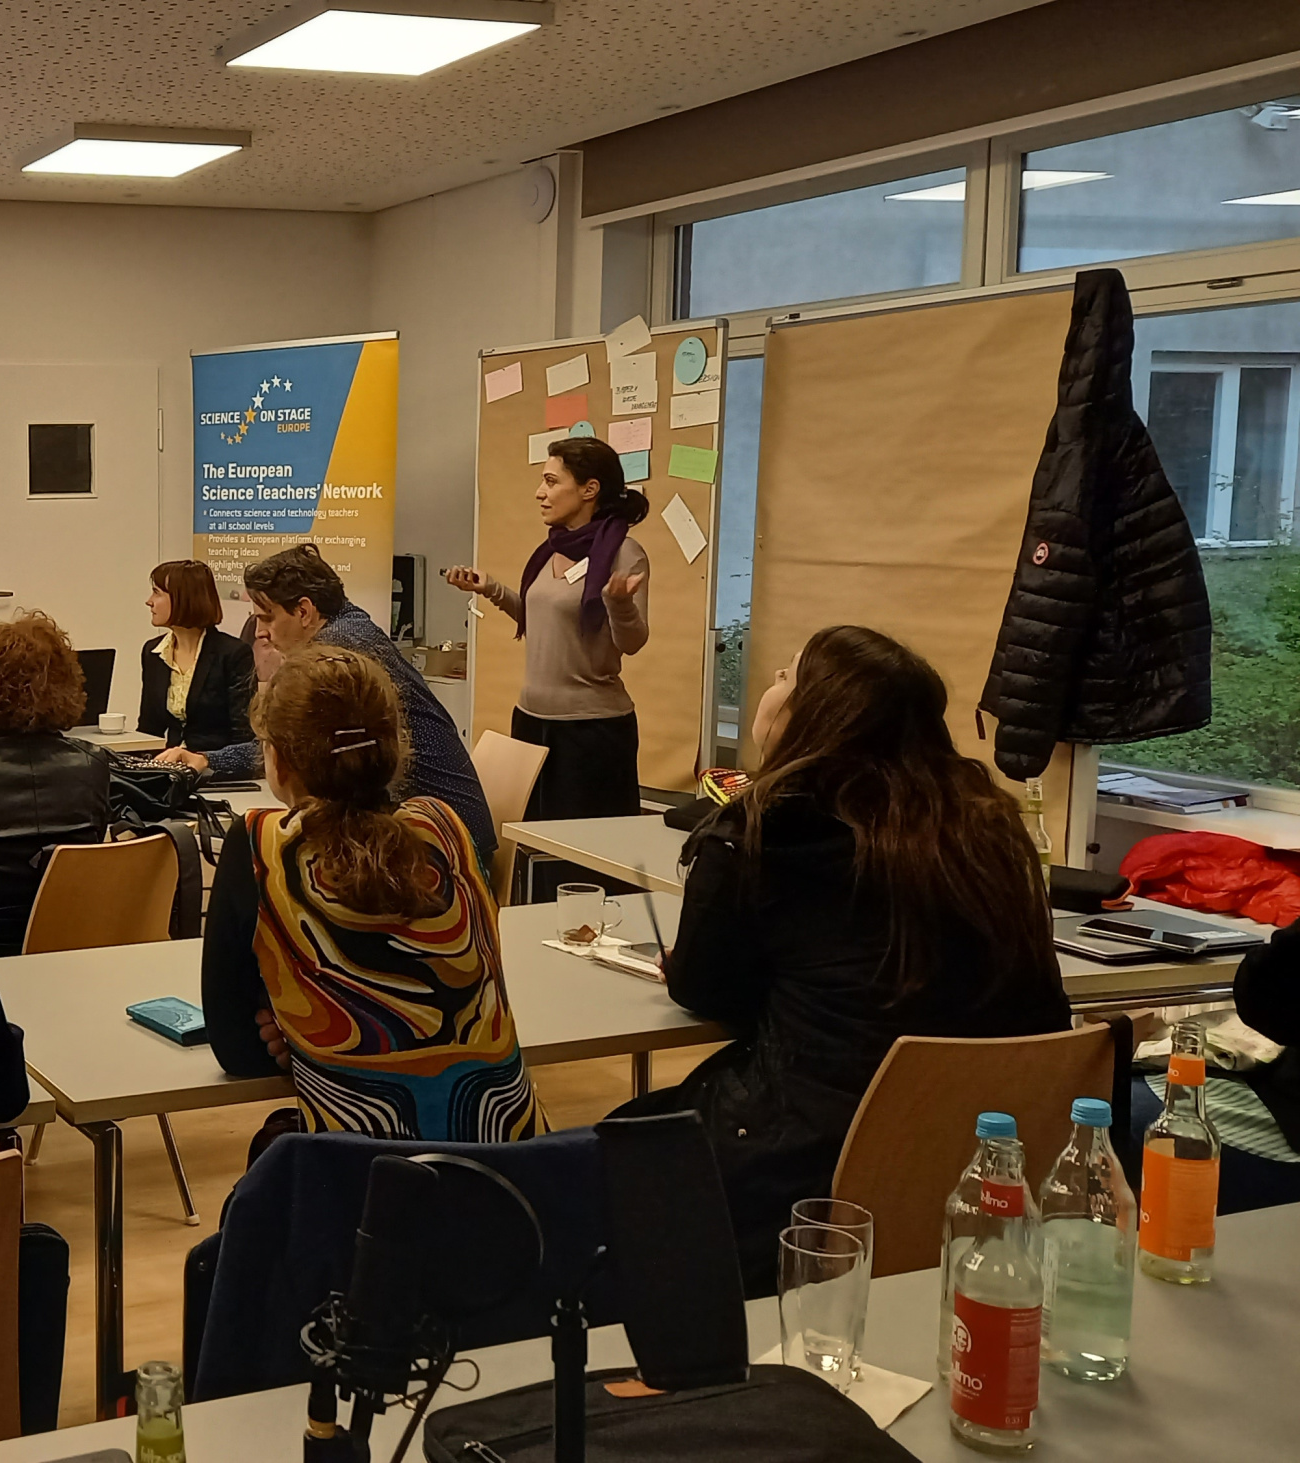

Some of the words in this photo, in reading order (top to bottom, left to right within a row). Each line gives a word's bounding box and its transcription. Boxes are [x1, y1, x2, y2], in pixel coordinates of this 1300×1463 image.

[201, 412, 240, 425] SCIENCE
[260, 410, 276, 422] ON
[278, 408, 311, 421] STAGE
[277, 423, 310, 433] EUROPE
[203, 464, 225, 478] The
[228, 463, 292, 482] European
[202, 485, 253, 500] Science
[324, 483, 383, 498] Network
[209, 509, 242, 517] Connects
[244, 509, 270, 517] science
[273, 509, 285, 517] and
[288, 509, 327, 519] technology
[328, 509, 359, 517] teachers
[218, 522, 226, 530] all
[228, 522, 252, 530] school
[254, 522, 274, 530] levels
[208, 535, 238, 543] Provides
[247, 535, 279, 545] European
[282, 535, 312, 545] platform
[313, 535, 323, 545] for
[325, 536, 366, 547] exchanging
[208, 548, 238, 558] teaching
[240, 548, 259, 556] ideas
[208, 560, 243, 571] Highlights
[337, 564, 350, 572] and
[213, 572, 244, 584] chnolog
